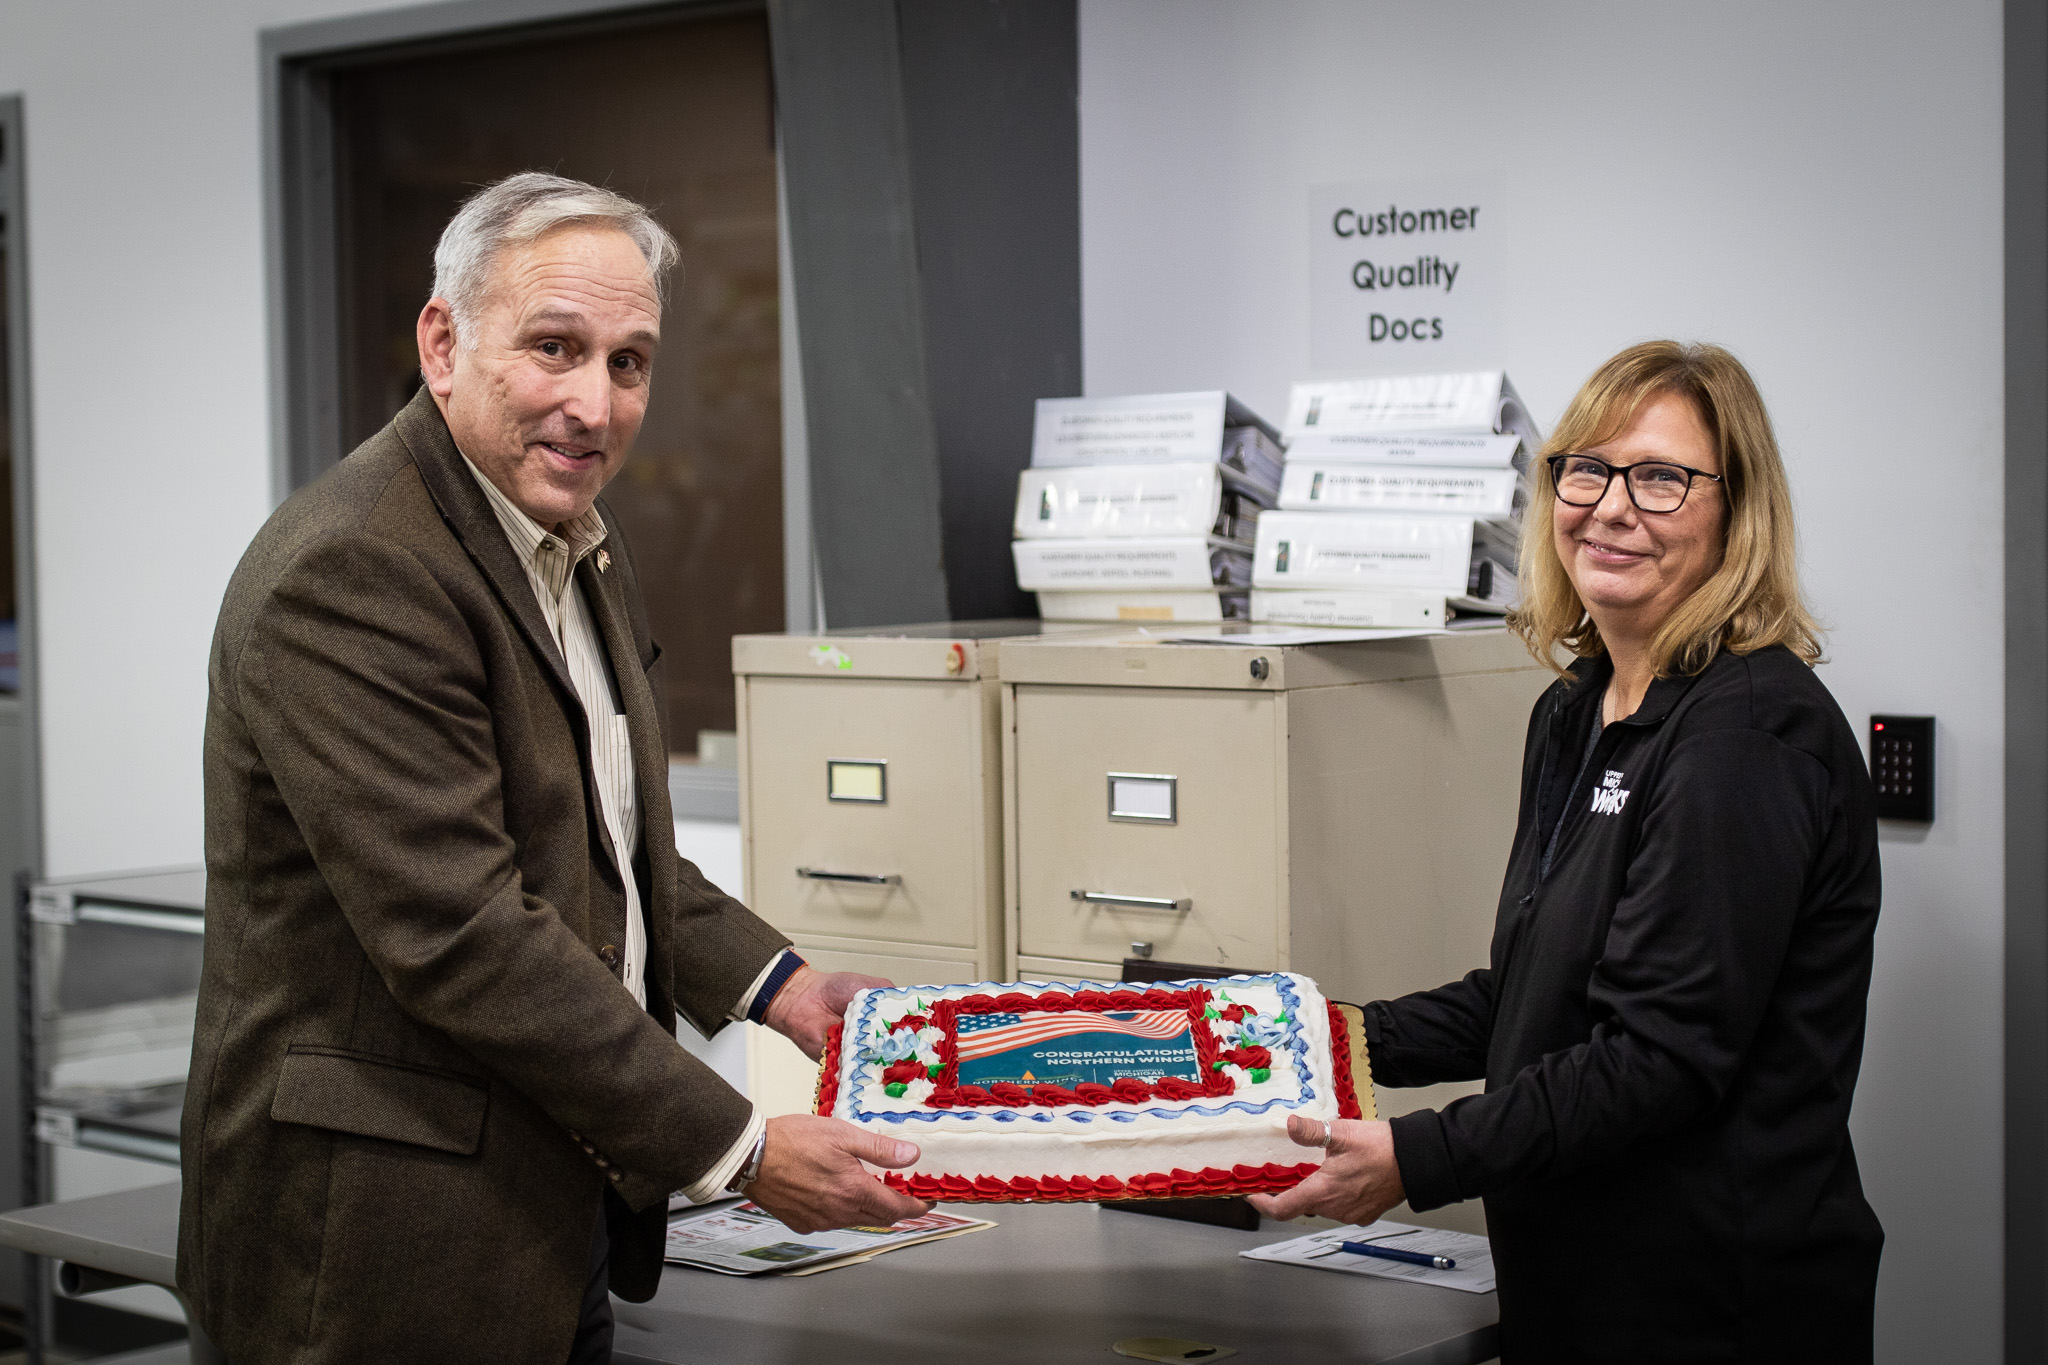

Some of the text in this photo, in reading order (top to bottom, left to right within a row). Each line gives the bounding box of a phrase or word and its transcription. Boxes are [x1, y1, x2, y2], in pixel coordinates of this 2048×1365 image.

[1332, 203, 1480, 238] Customer
[1352, 256, 1460, 292] Quality
[1369, 312, 1443, 342] Docs
[1033, 1048, 1194, 1059] CONGRATULATIONS
[1047, 1055, 1195, 1066] NORTHERN WINGS
[1044, 1076, 1085, 1084] WINGS
